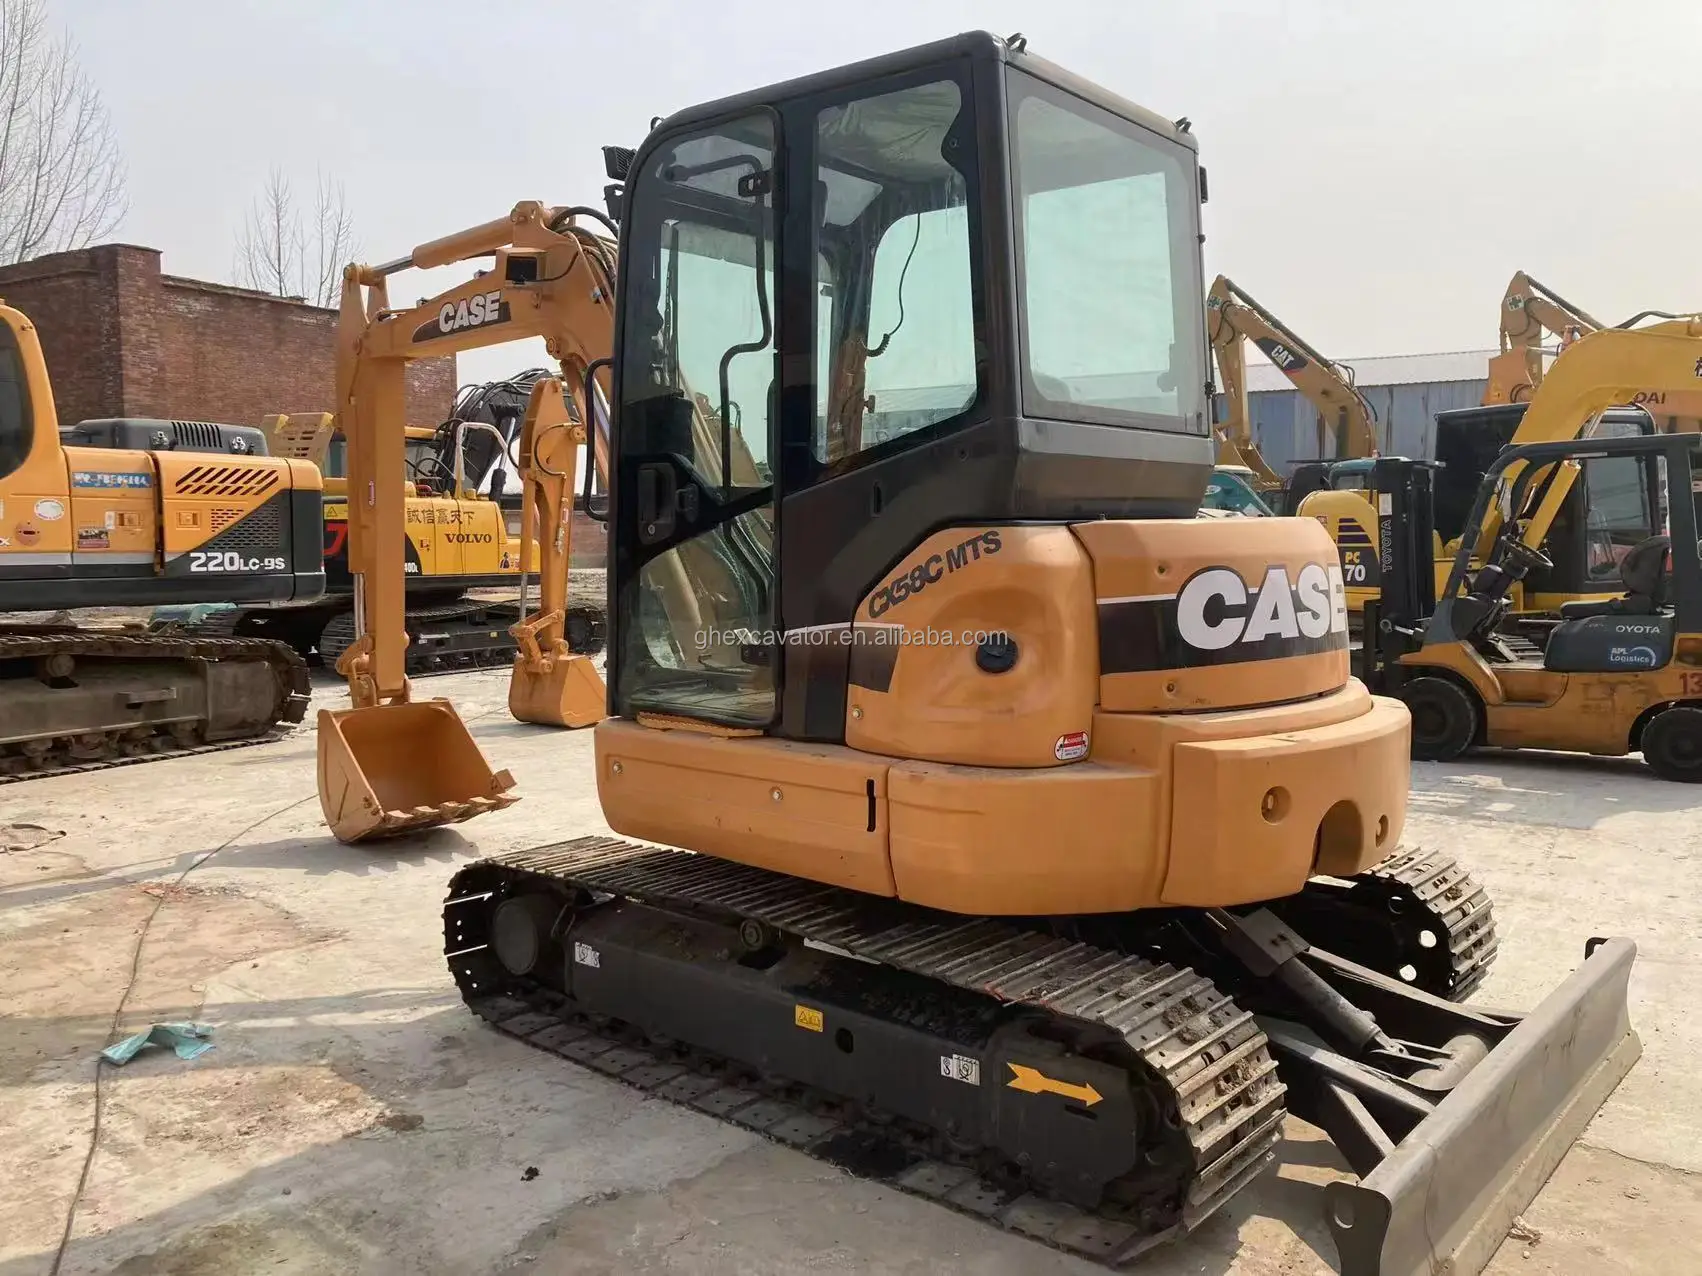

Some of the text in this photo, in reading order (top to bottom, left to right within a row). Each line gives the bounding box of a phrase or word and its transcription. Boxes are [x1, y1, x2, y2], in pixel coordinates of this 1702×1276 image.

[438, 291, 500, 333] CASE
[1271, 345, 1294, 368] CAT
[444, 533, 493, 544] VOLVO
[1381, 519, 1393, 573] TOYOTA
[1344, 551, 1361, 563] PC
[868, 530, 1002, 619] CX58C MTS
[1344, 564, 1366, 582] 70
[1176, 563, 1348, 650] CASE
[1610, 654, 1650, 663] Logistics
